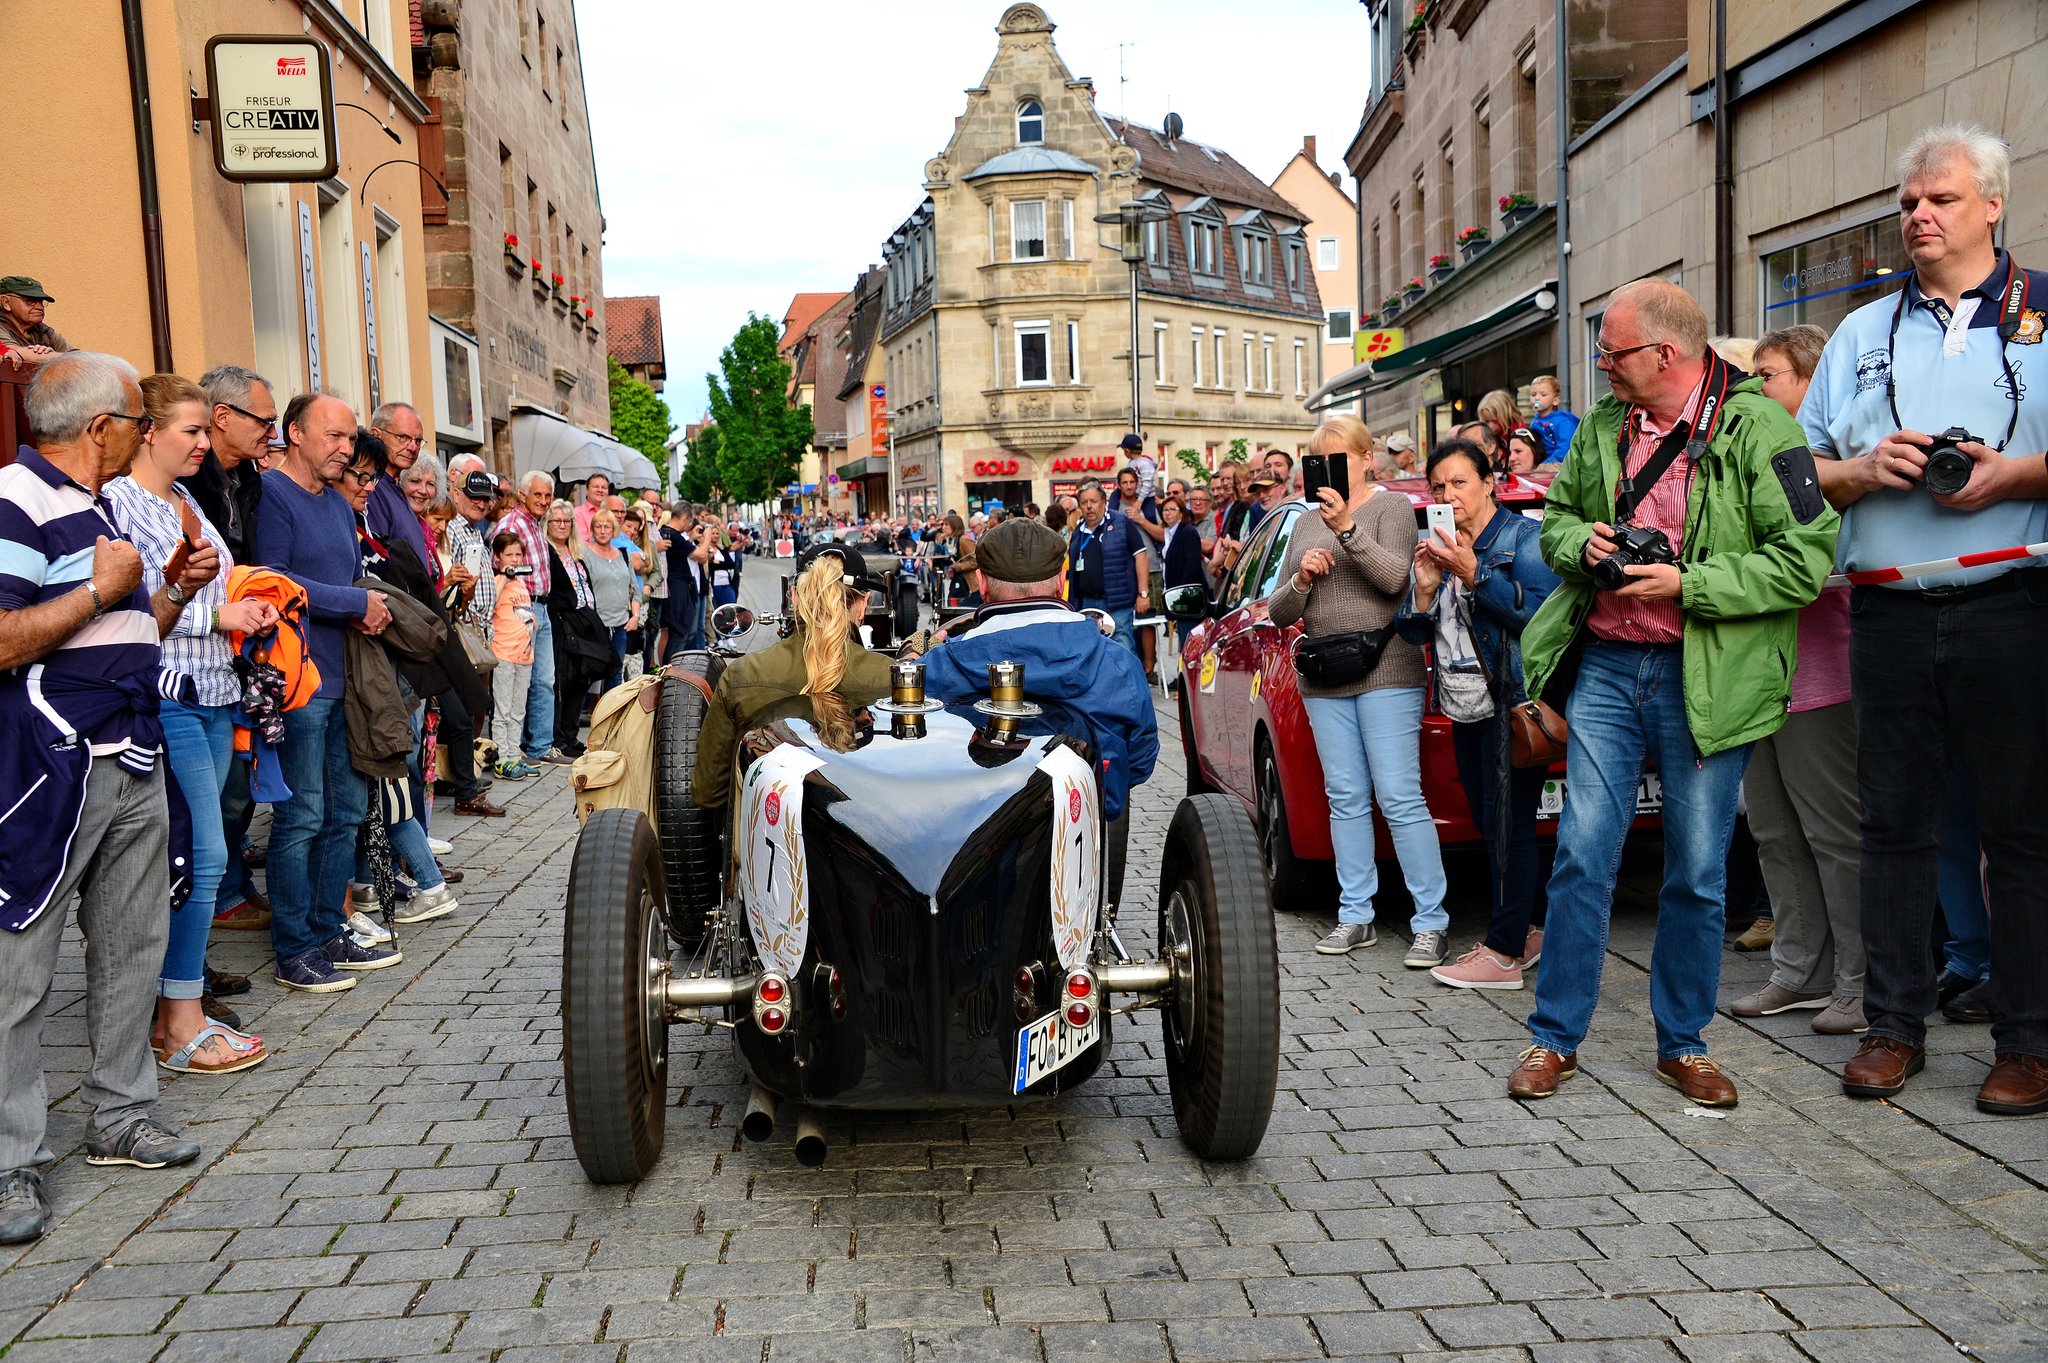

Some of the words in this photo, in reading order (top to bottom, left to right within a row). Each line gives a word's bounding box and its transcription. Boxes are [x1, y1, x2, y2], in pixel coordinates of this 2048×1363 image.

[277, 67, 306, 76] WELLA
[246, 96, 291, 106] FRISEUR
[226, 111, 318, 129] CREATIV
[253, 147, 319, 161] professional
[1800, 264, 1826, 289] OPTIK
[2007, 280, 2024, 314] Canon
[1698, 396, 1717, 431] Canon
[974, 459, 1020, 476] GOLD
[1052, 455, 1116, 474] ANKAUF
[1027, 1025, 1048, 1080] FO
